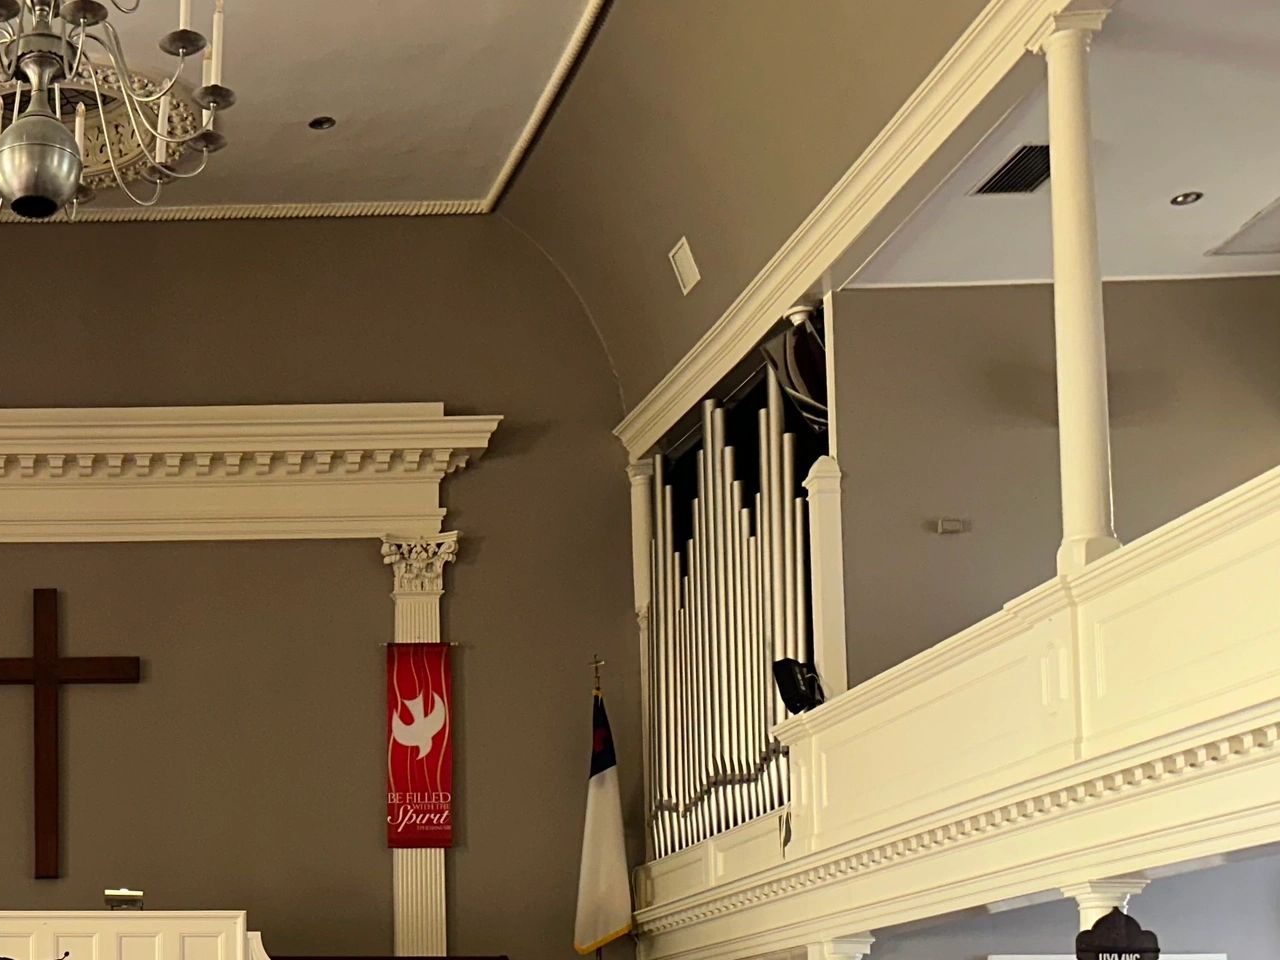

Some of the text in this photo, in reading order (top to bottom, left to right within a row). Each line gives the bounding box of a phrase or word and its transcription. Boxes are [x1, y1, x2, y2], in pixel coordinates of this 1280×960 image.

[388, 792, 451, 803] BE FILLED
[387, 805, 451, 832] Spirit
